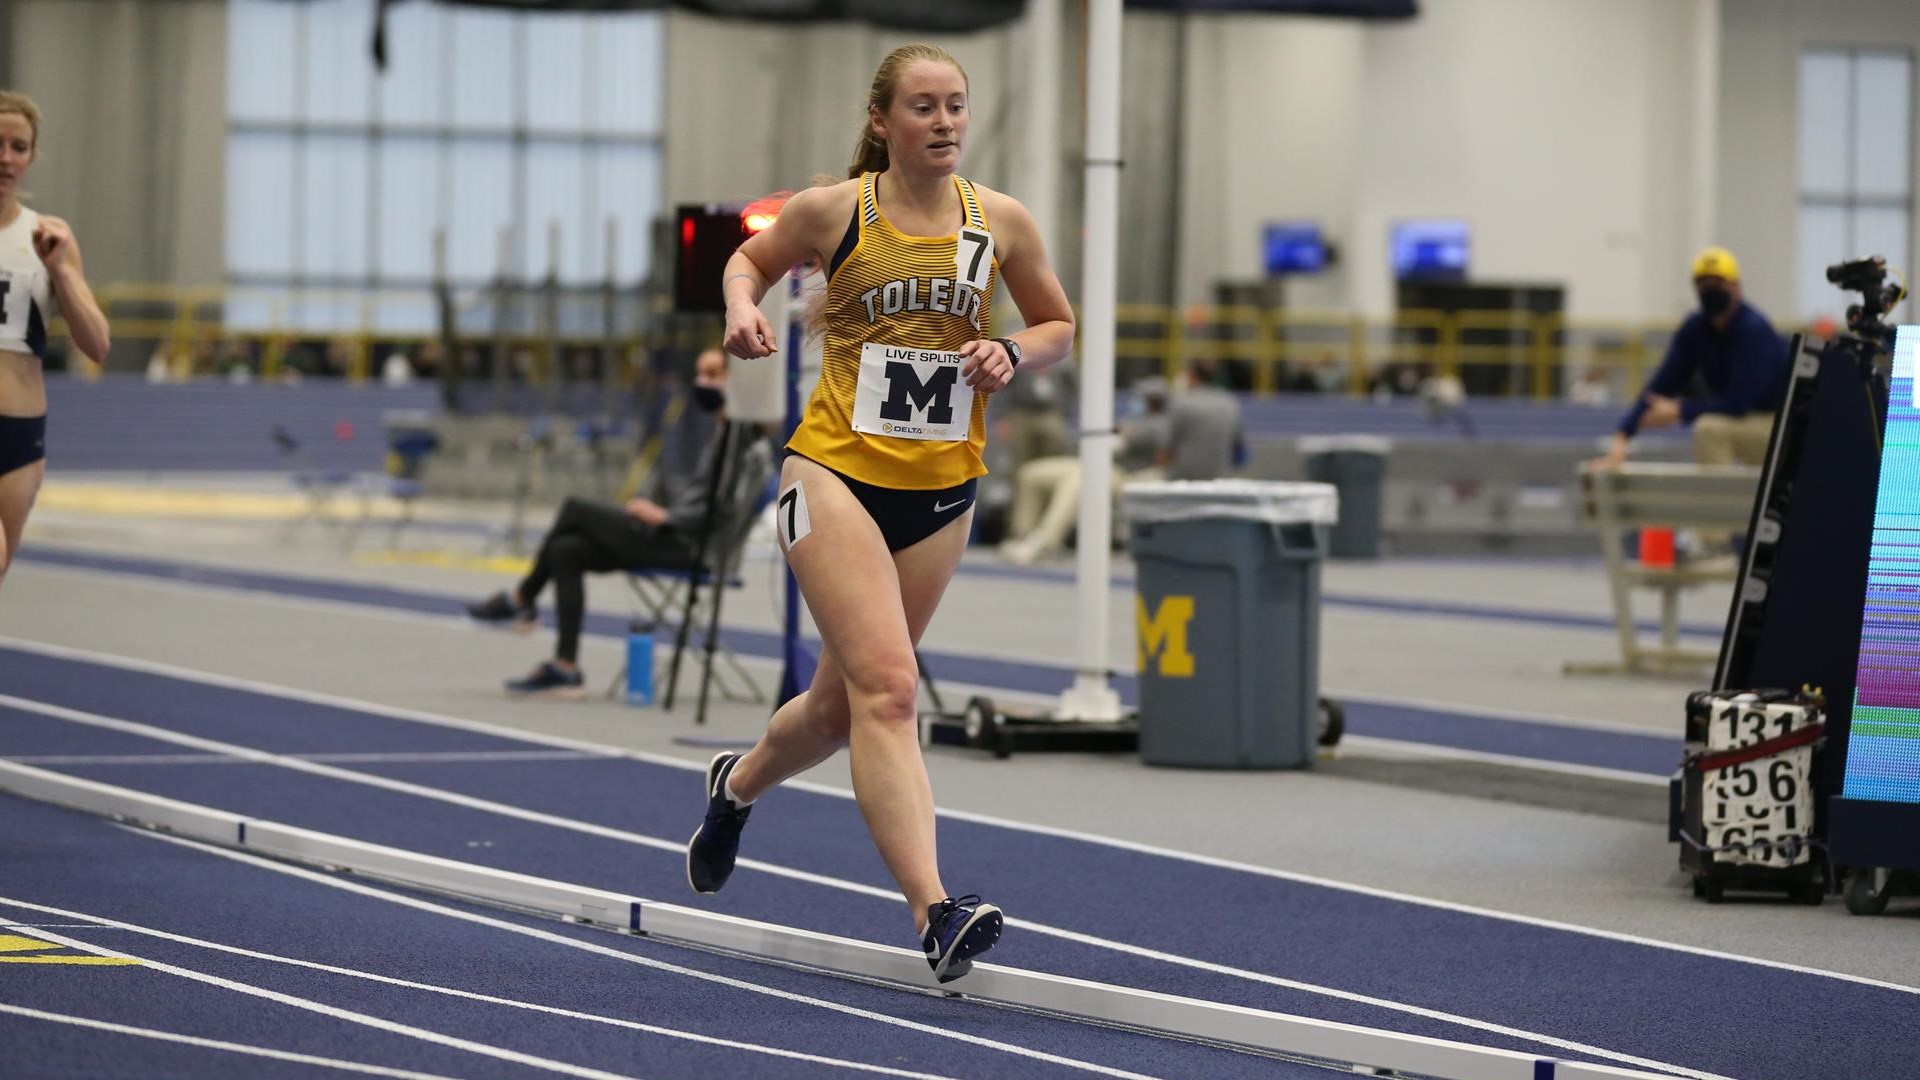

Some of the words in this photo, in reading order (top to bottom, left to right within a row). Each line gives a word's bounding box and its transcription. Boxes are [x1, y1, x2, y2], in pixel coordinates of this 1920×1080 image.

[962, 230, 989, 283] 7
[885, 348, 916, 361] LIVE
[919, 352, 960, 364] SPLITS
[879, 360, 959, 425] M
[779, 487, 798, 544] 7
[1136, 592, 1195, 677] M
